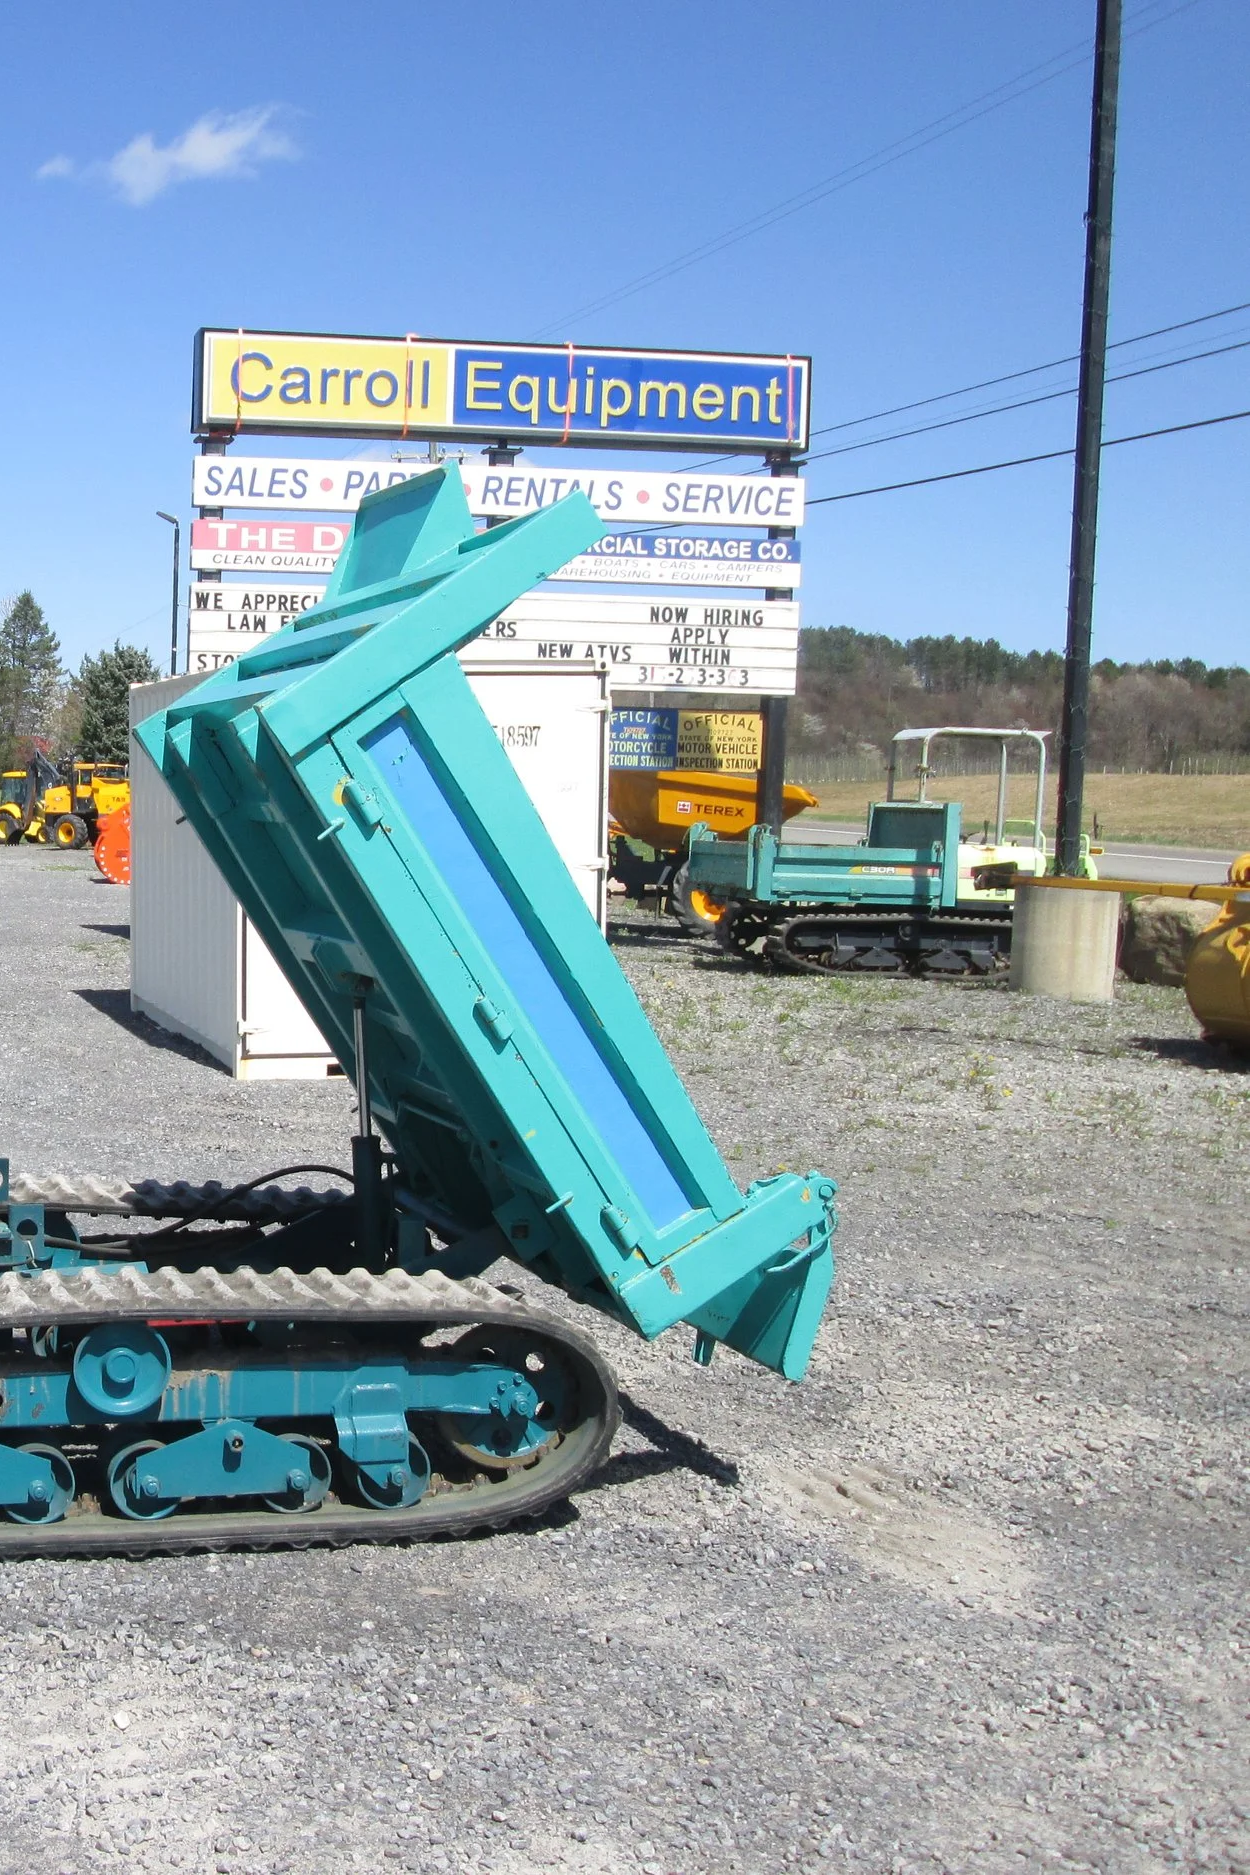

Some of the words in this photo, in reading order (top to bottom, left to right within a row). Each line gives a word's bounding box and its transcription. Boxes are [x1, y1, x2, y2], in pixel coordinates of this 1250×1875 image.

[230, 352, 430, 409] Carroll
[466, 360, 782, 428] Equipment
[204, 465, 309, 499] SALES
[662, 482, 795, 516] SERVICE
[207, 522, 297, 550] THE
[654, 537, 752, 559] STORAGE
[757, 541, 793, 560] CO.
[212, 553, 267, 566] CLEAN
[271, 555, 338, 568] QUALITY
[593, 558, 639, 568] BOATS
[659, 560, 696, 570] CARS
[716, 561, 784, 573] CAMPERS
[553, 567, 651, 579] AREHOUSING
[671, 571, 754, 583] EQUIPMENT
[195, 592, 223, 610] WE
[227, 613, 267, 632] LAW
[650, 606, 689, 624] NOW
[704, 608, 764, 627] HIRING
[671, 627, 730, 645] APPLY
[537, 642, 574, 658] NEW
[584, 643, 632, 662] ATVS
[669, 647, 730, 666] WITHIN
[610, 710, 671, 731] FFICIAL
[683, 714, 756, 733] OFFICIAL
[631, 732, 650, 740] NEW
[678, 734, 702, 742] STATE
[609, 740, 667, 755] OTORCYCLE
[677, 742, 712, 754] MOTOR
[715, 743, 758, 755] VEHICLE
[640, 755, 674, 768] STATION
[676, 756, 723, 769] INSPECTION
[725, 757, 758, 770] STATION
[694, 803, 745, 818] TEREX
